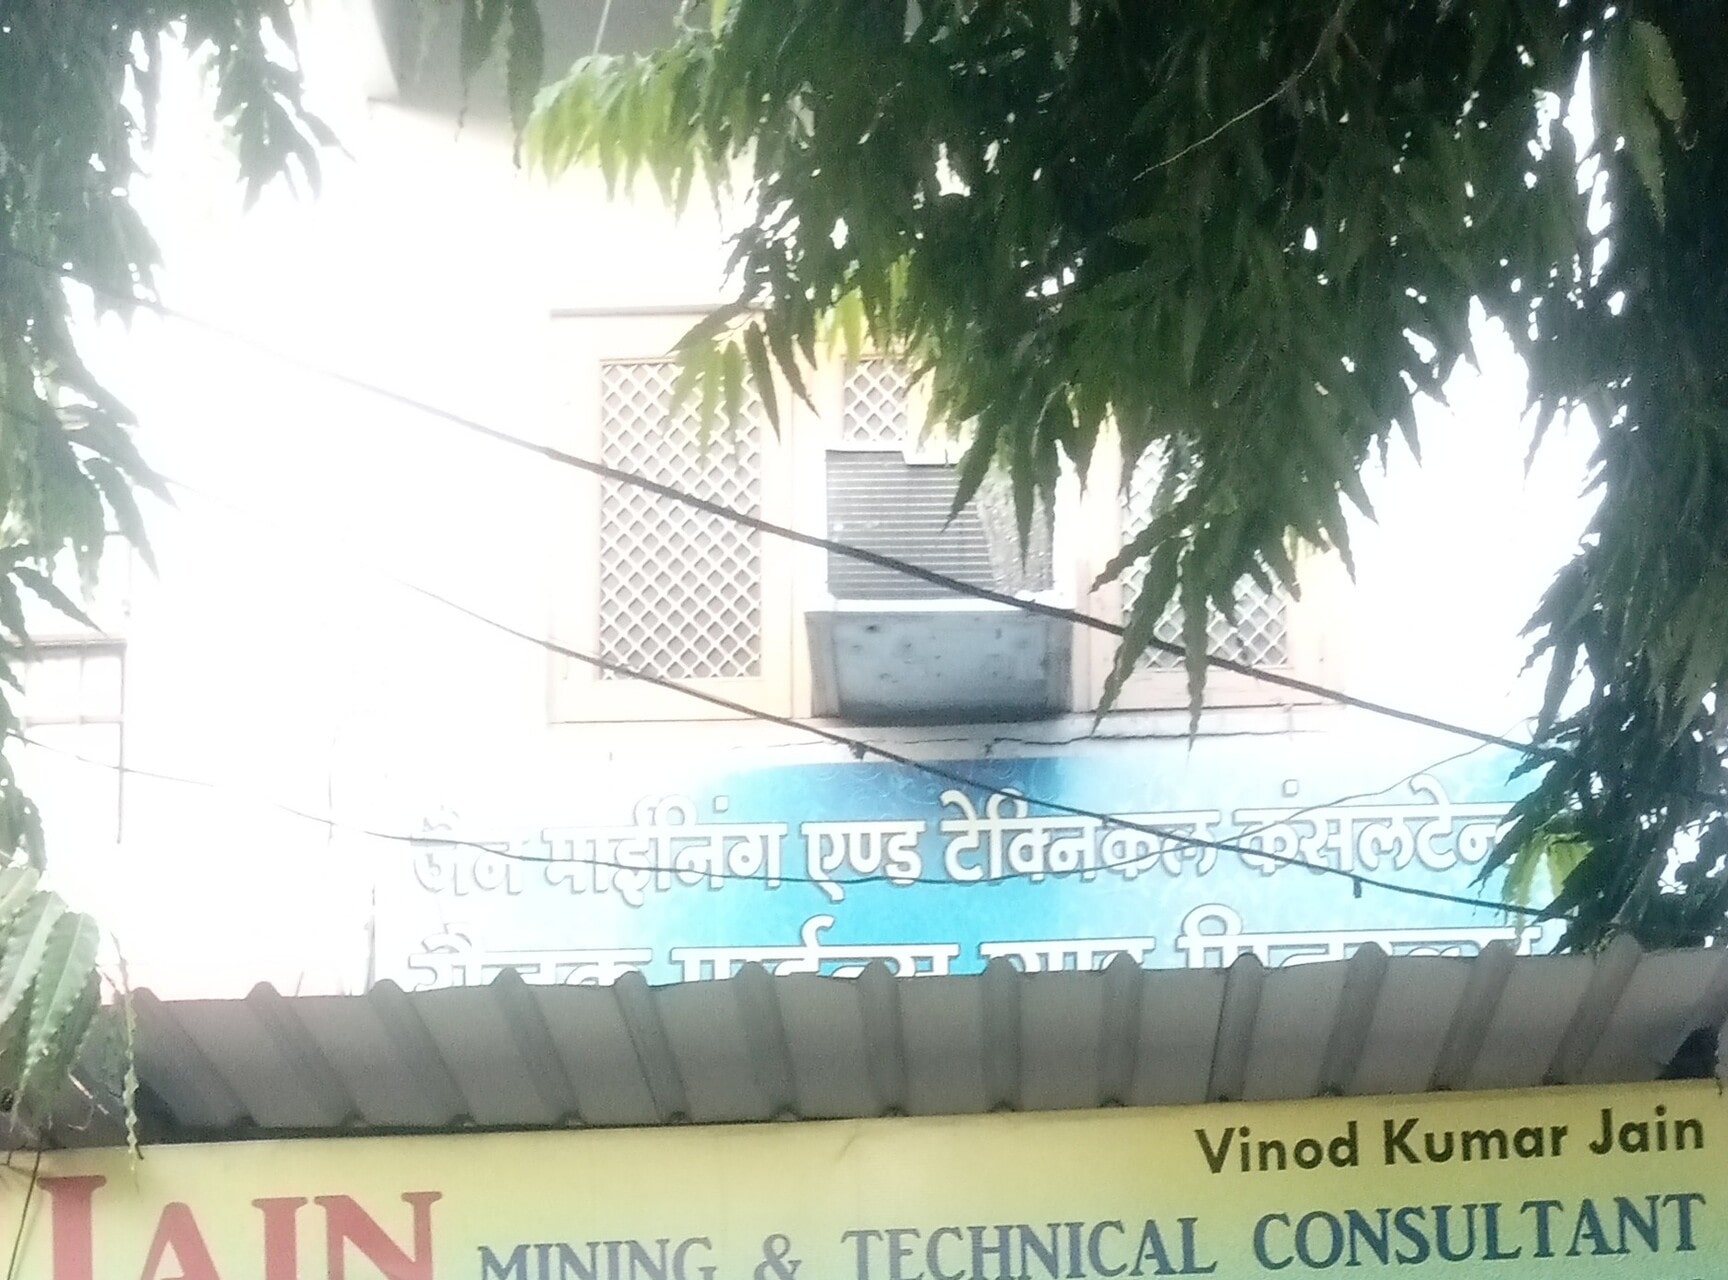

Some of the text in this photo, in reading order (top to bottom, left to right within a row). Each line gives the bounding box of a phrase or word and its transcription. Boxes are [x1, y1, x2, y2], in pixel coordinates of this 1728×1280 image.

[800, 818, 926, 903] एण्ड
[1195, 1103, 1707, 1174] Vinod Kumar Jain
[1252, 1192, 1707, 1272] CONSULTANT
